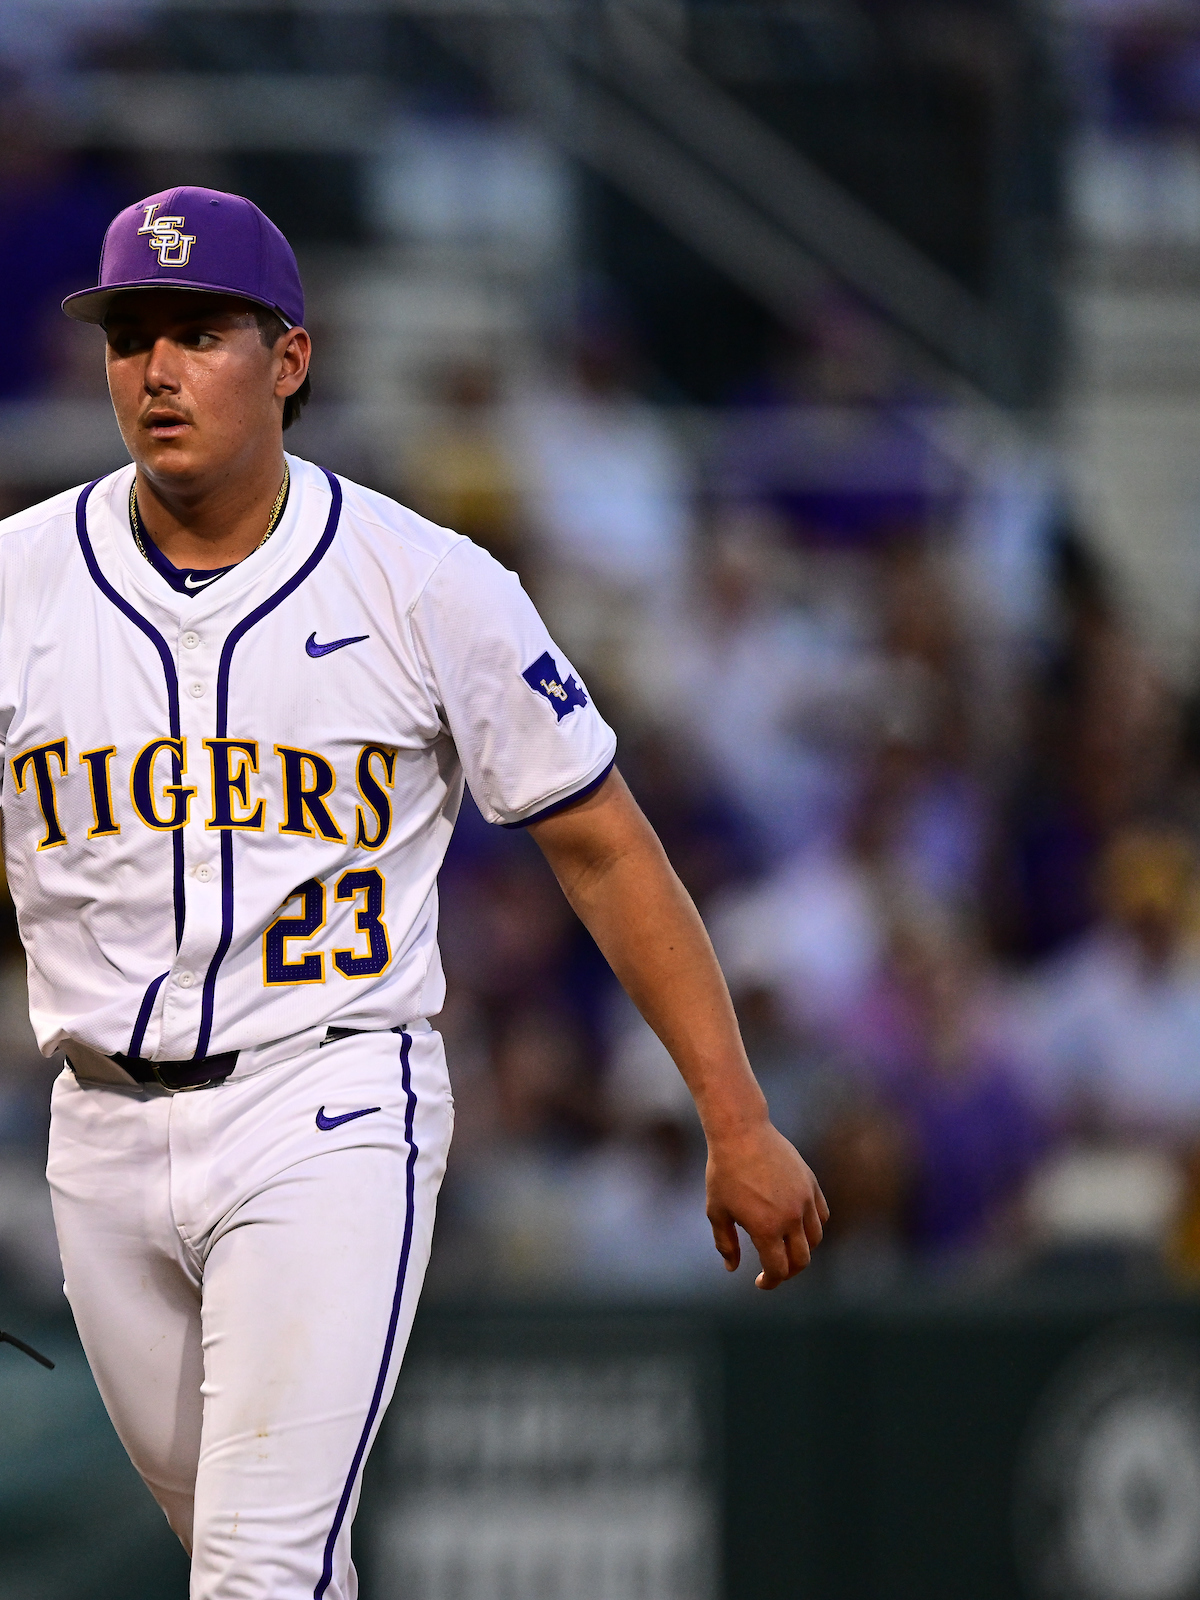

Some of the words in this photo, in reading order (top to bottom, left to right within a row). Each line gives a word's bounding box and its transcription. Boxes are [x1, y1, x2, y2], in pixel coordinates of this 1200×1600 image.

[137, 203, 196, 267] LSU
[540, 679, 568, 701] LSU
[9, 736, 398, 852] TIGERS
[262, 866, 392, 988] 23
